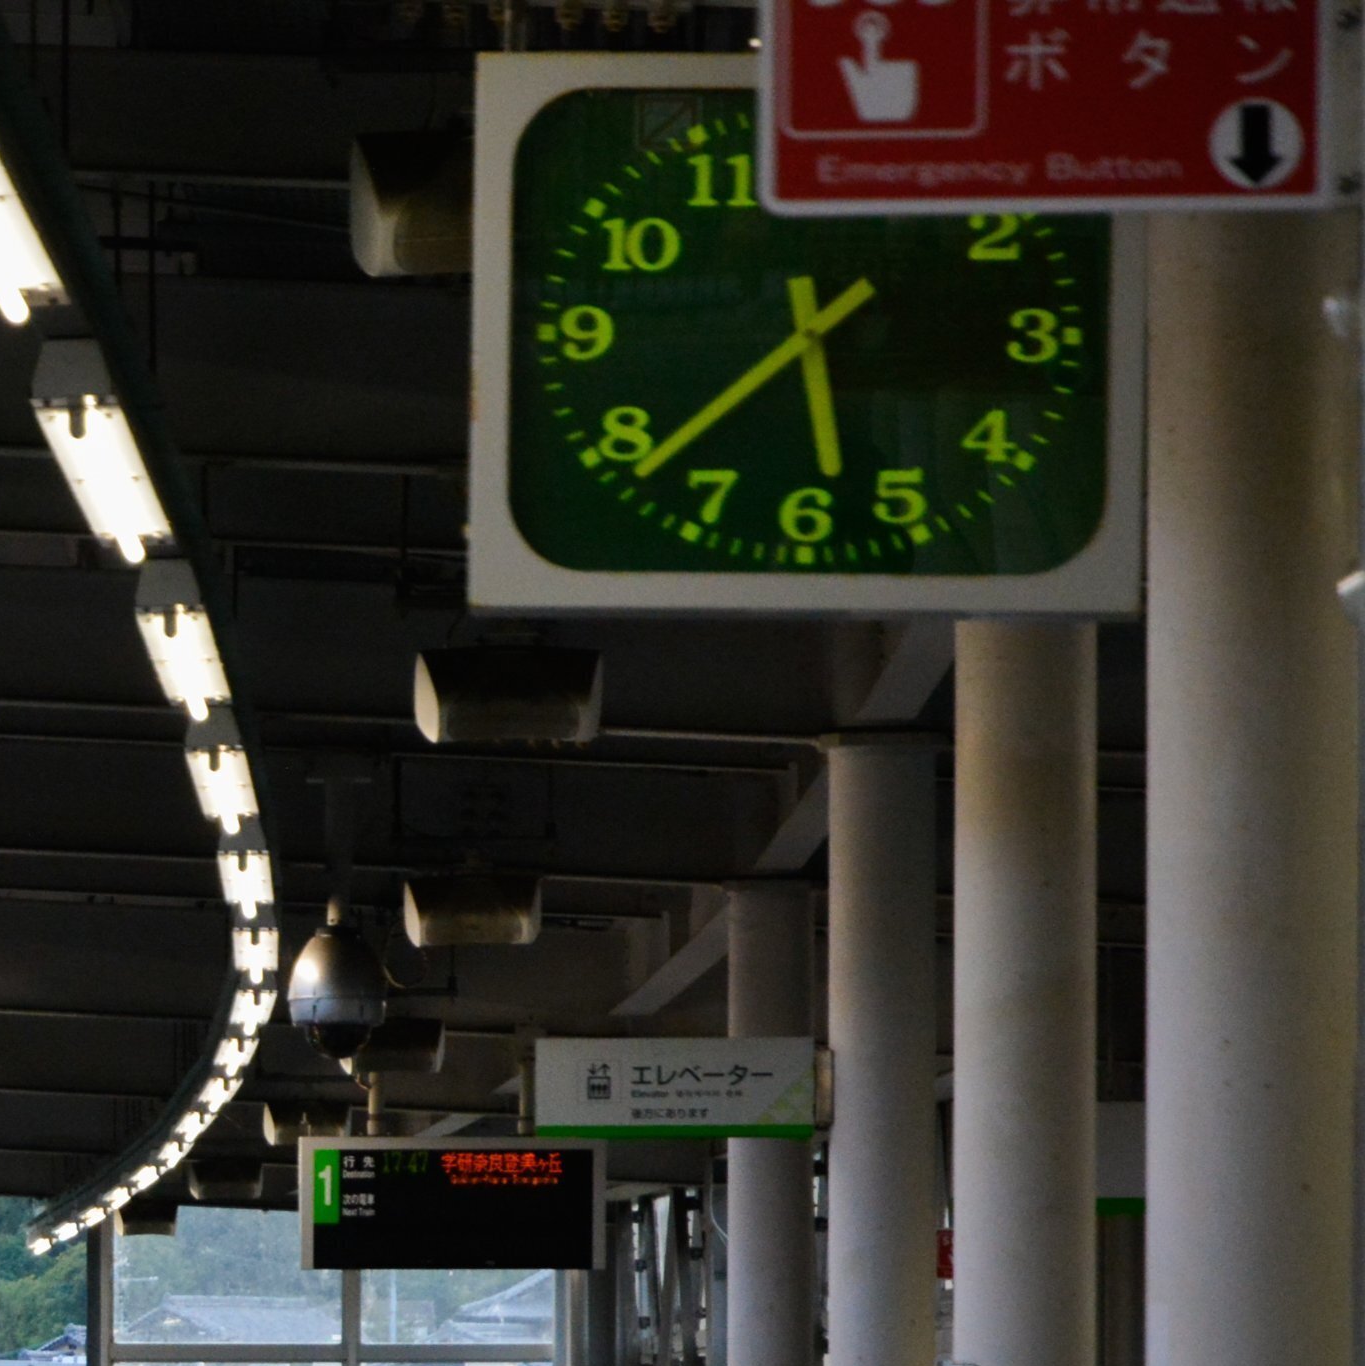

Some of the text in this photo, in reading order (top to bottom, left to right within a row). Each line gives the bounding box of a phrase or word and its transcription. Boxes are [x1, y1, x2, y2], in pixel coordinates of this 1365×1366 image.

[686, 153, 757, 208] 11
[817, 152, 1182, 185] Emergency Button
[601, 217, 682, 273] 10
[967, 214, 1022, 262] 2
[559, 305, 616, 362] 9
[1006, 307, 1060, 365] 3
[597, 405, 654, 463] 8
[962, 409, 1017, 465] 4
[687, 468, 741, 525] 7
[777, 486, 833, 543] 6
[871, 469, 928, 526] 5
[631, 1063, 774, 1087] エレベーター
[317, 1164, 333, 1207] 1
